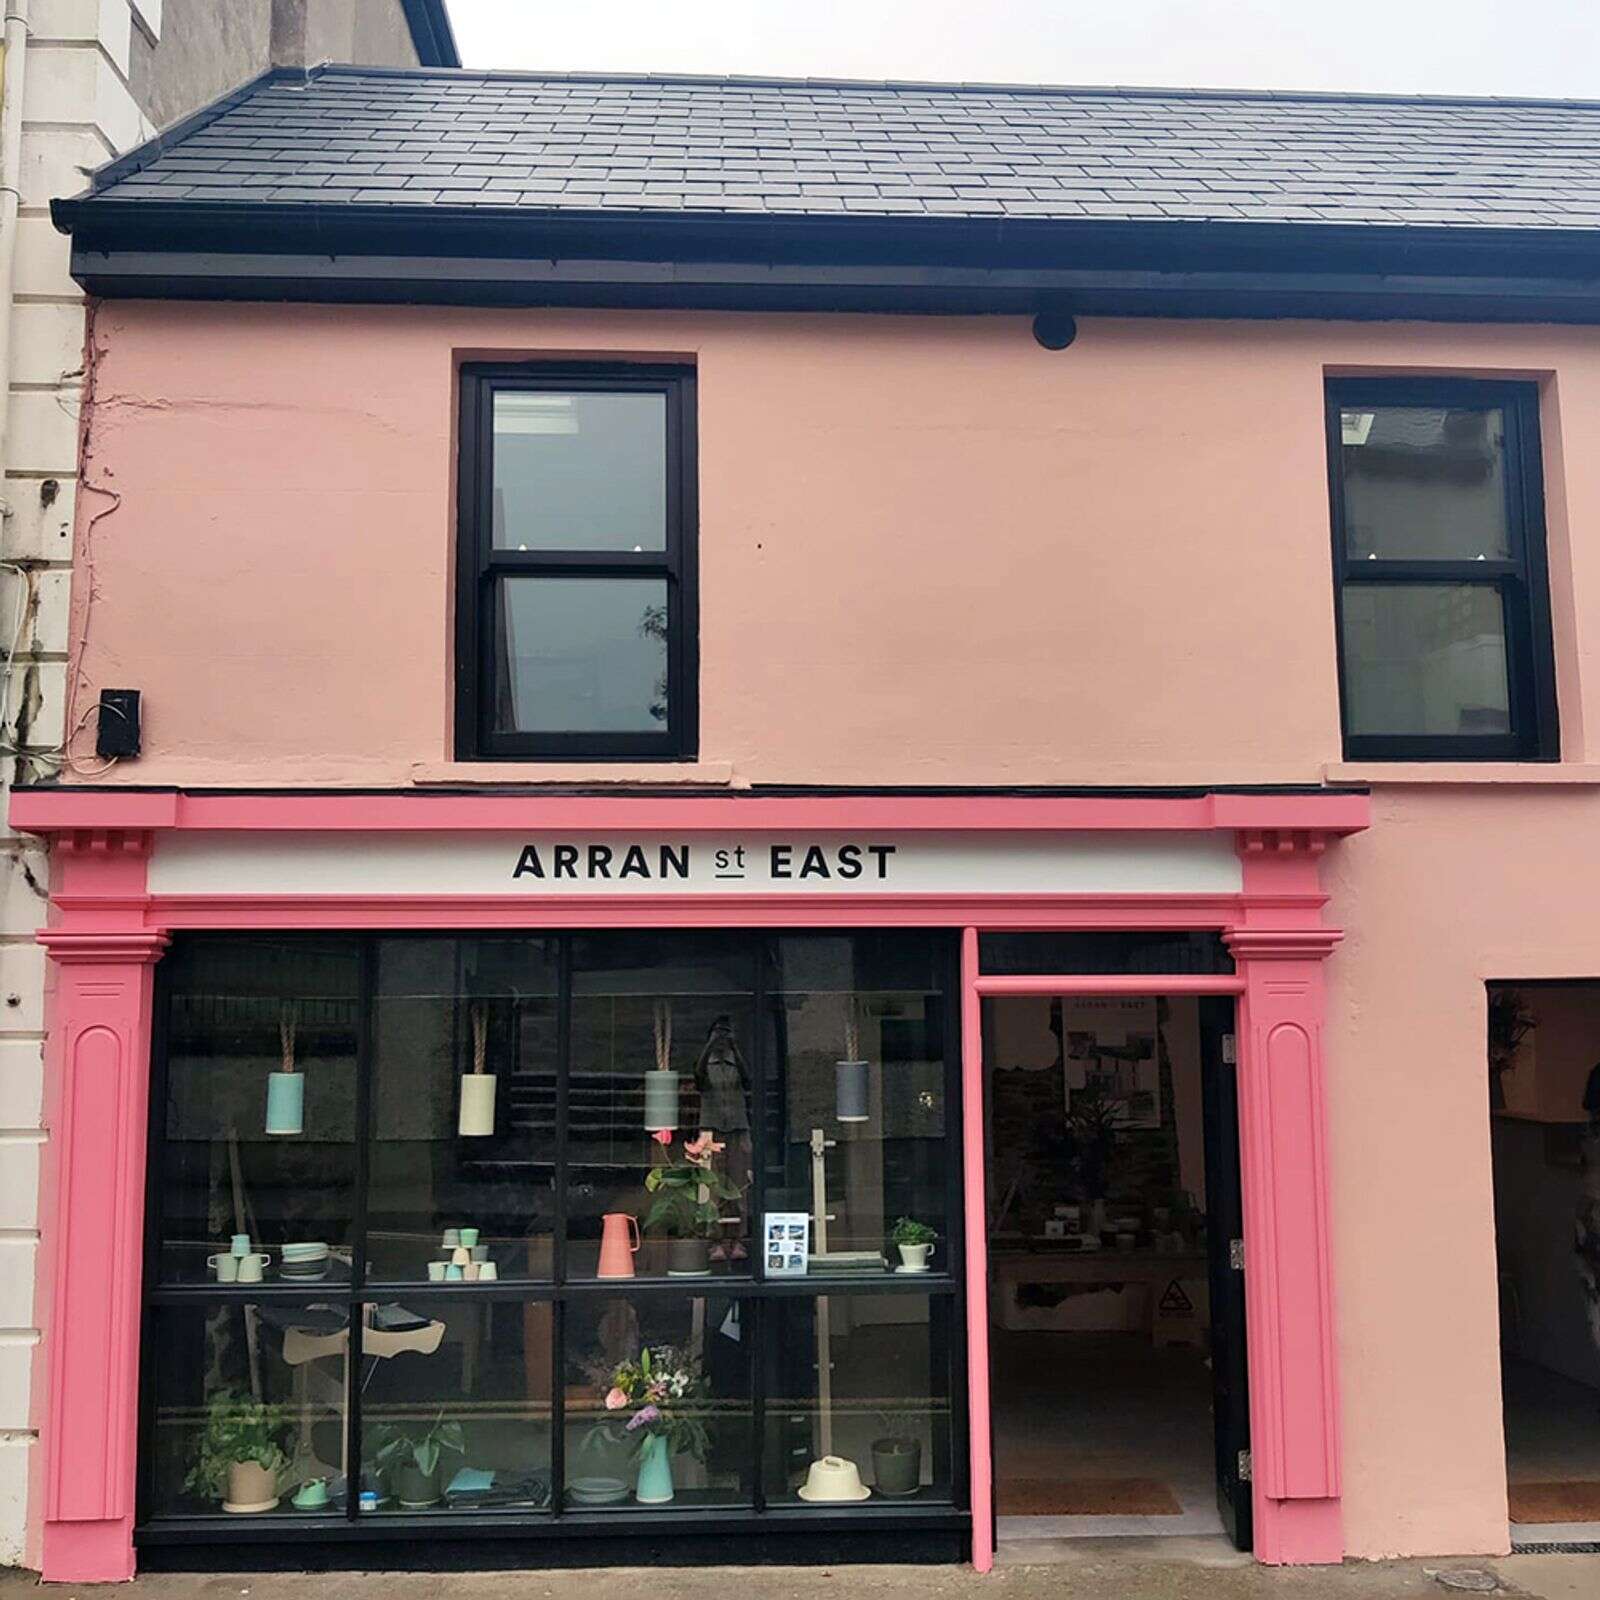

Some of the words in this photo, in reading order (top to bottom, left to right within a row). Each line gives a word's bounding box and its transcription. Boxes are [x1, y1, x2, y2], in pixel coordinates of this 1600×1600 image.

[512, 845, 690, 879] ARRAN
[715, 845, 746, 868] st
[770, 845, 897, 879] EAST
